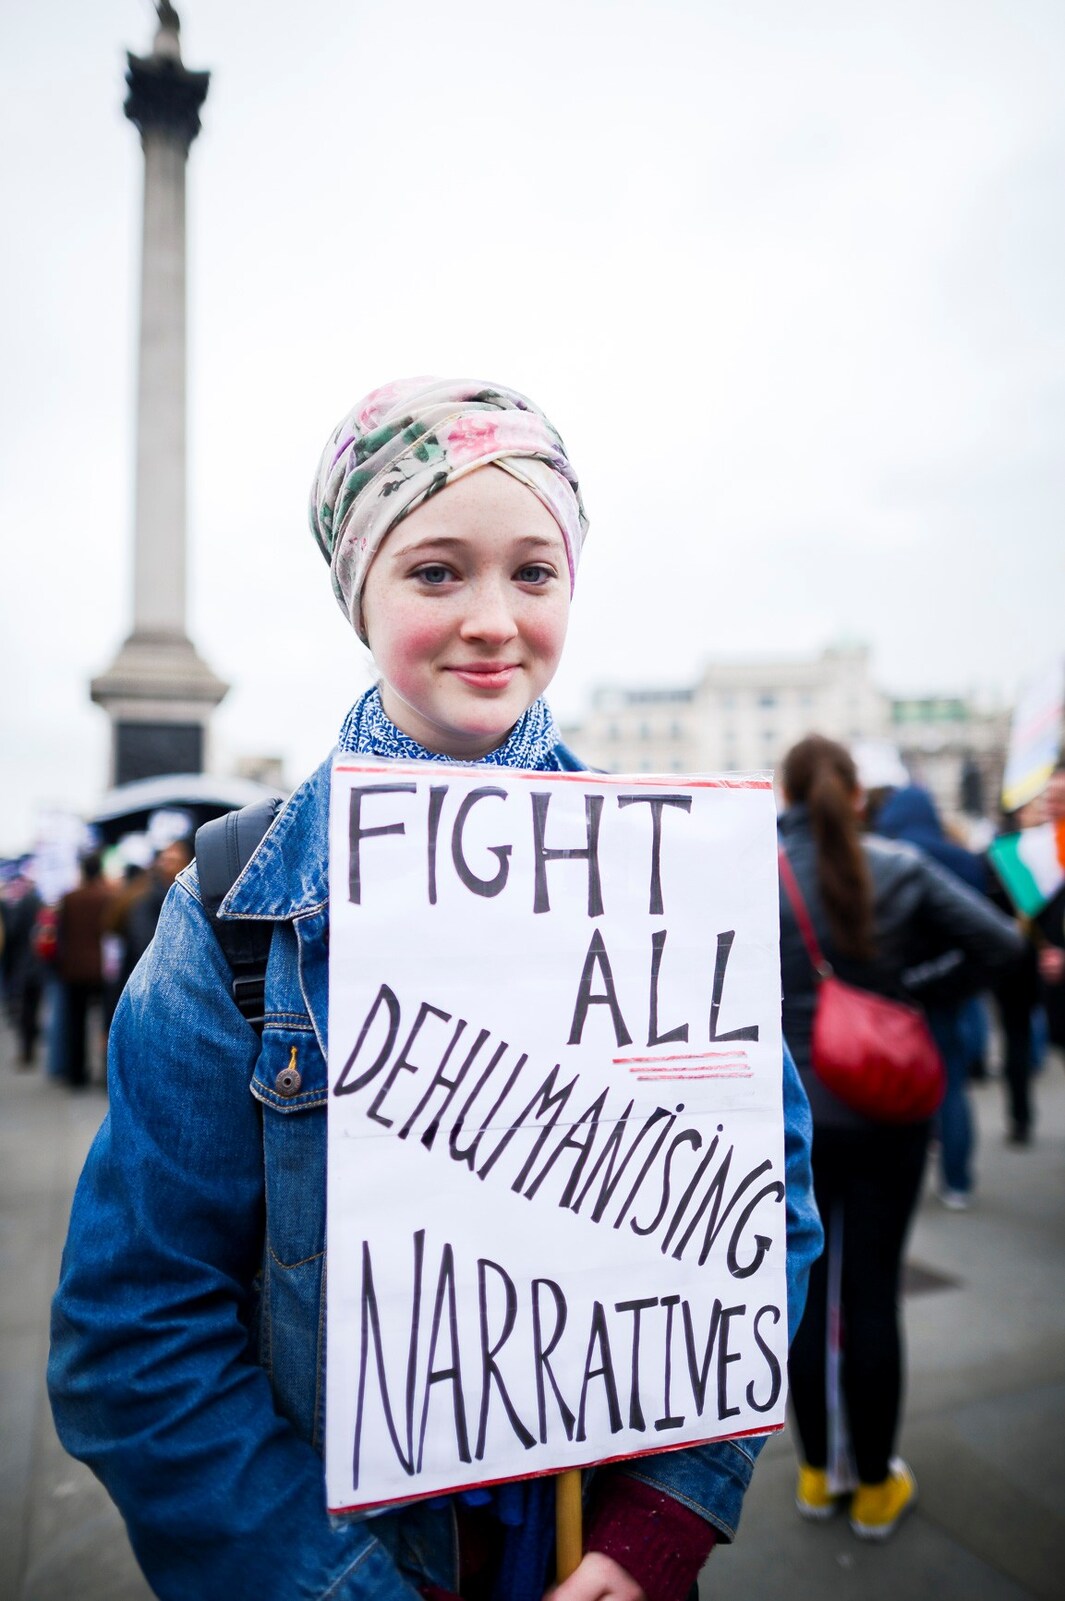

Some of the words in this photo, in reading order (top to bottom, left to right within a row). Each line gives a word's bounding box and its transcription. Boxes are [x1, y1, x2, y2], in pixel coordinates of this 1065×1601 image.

[348, 782, 692, 918] FIGHT
[567, 928, 759, 1048] ALL
[354, 1228, 782, 1490] NARRATIVES
